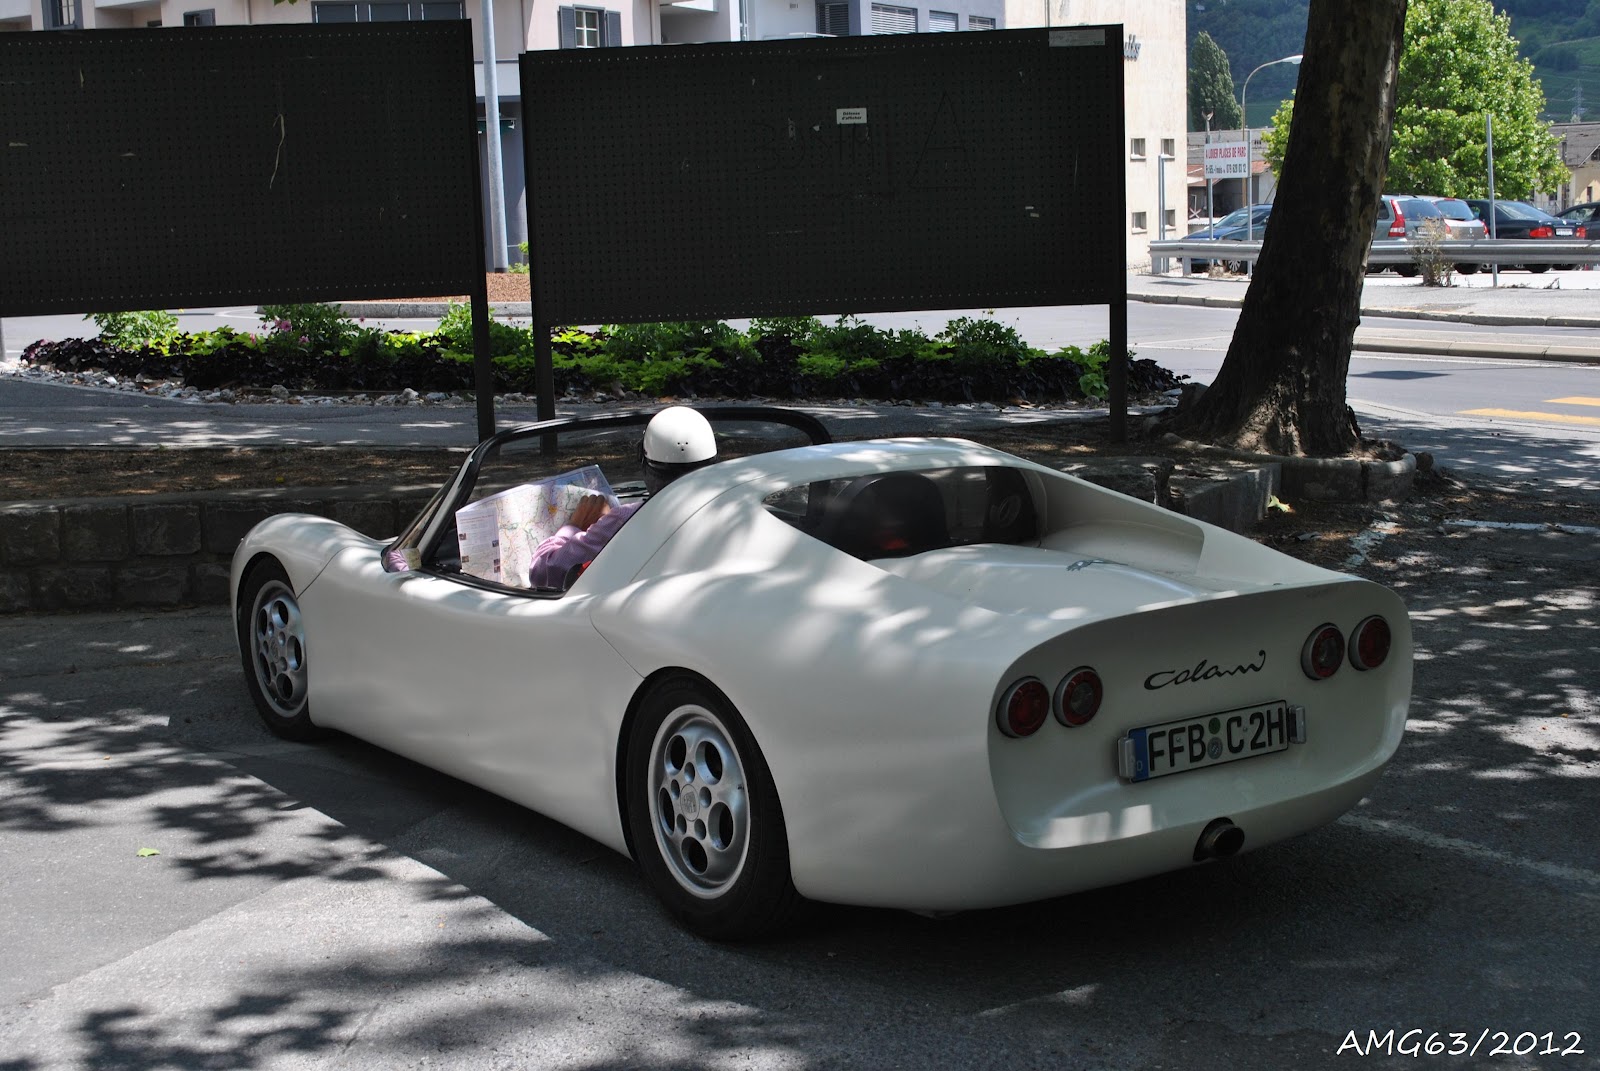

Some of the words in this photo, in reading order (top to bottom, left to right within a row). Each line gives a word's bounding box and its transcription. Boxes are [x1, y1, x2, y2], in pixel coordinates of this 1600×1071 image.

[1208, 148, 1218, 159] LOUER
[1219, 147, 1231, 158] PLACES
[1232, 147, 1236, 157] DE
[1237, 146, 1246, 157] PARC
[1148, 724, 1206, 771] FFB
